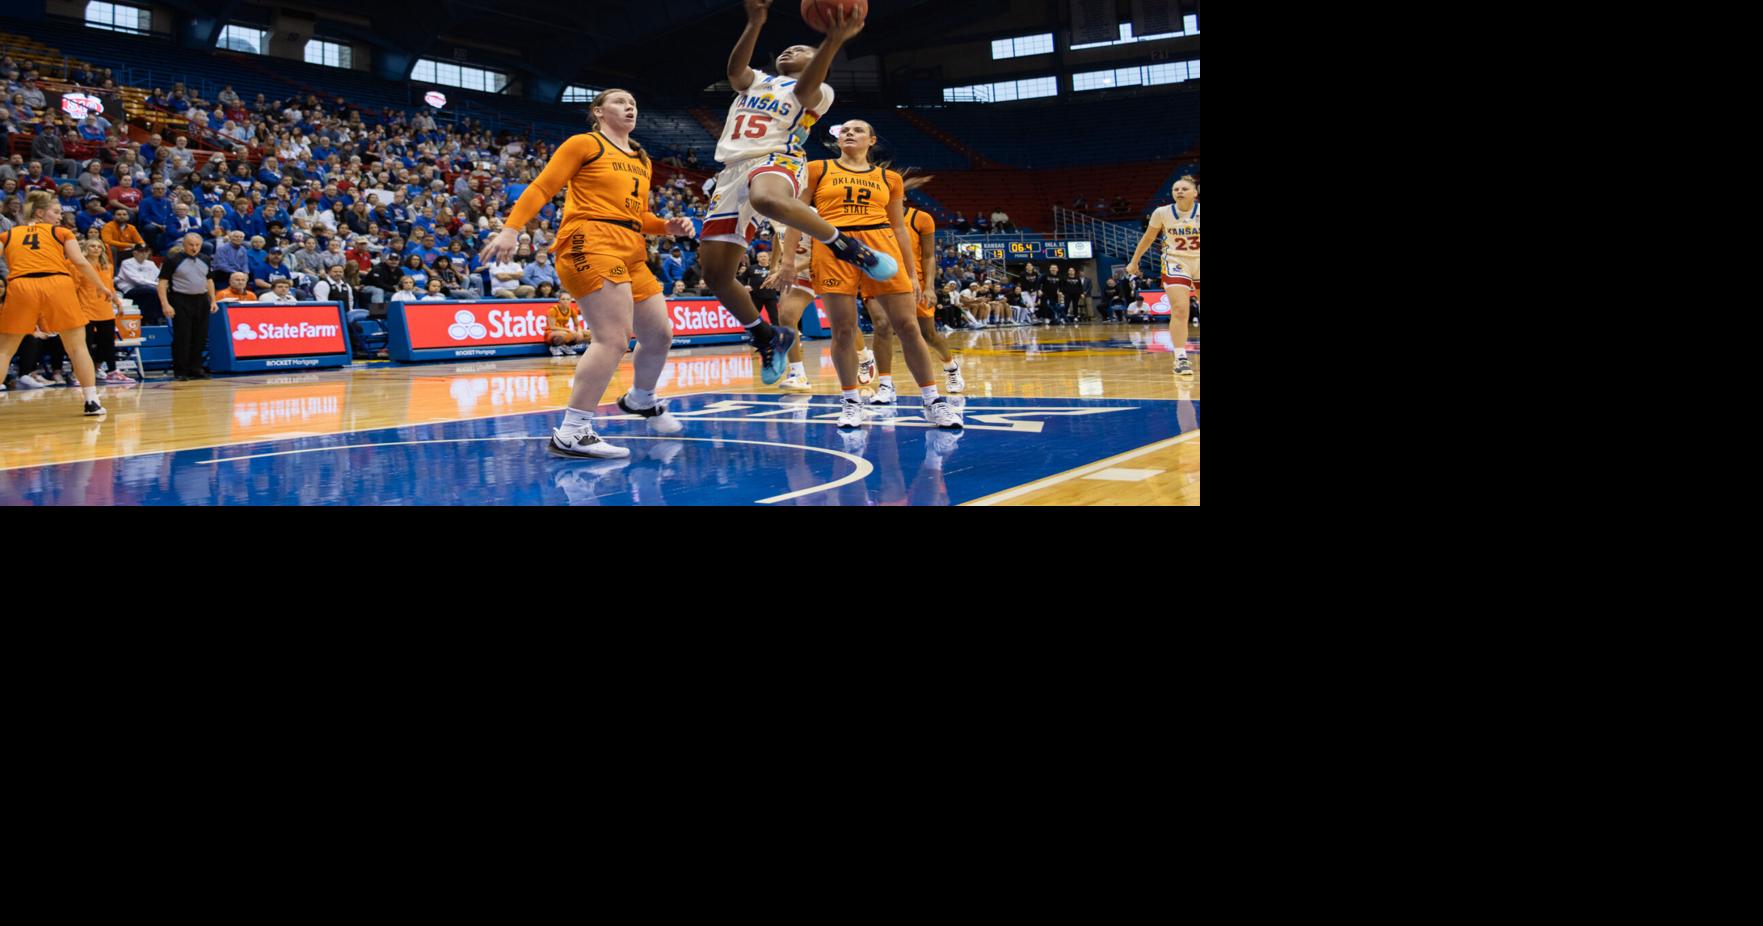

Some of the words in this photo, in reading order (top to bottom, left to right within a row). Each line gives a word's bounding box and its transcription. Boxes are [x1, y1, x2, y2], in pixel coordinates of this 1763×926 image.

[731, 114, 773, 141] 15
[631, 176, 639, 197] 1
[832, 177, 882, 191] OKLAHOMA
[843, 186, 872, 205] 12
[843, 205, 869, 215] STATE
[1168, 227, 1200, 236] KANSA
[22, 233, 40, 250] 4
[1175, 236, 1200, 251] 23
[1054, 249, 1065, 257] 15
[673, 305, 741, 330] StateFa
